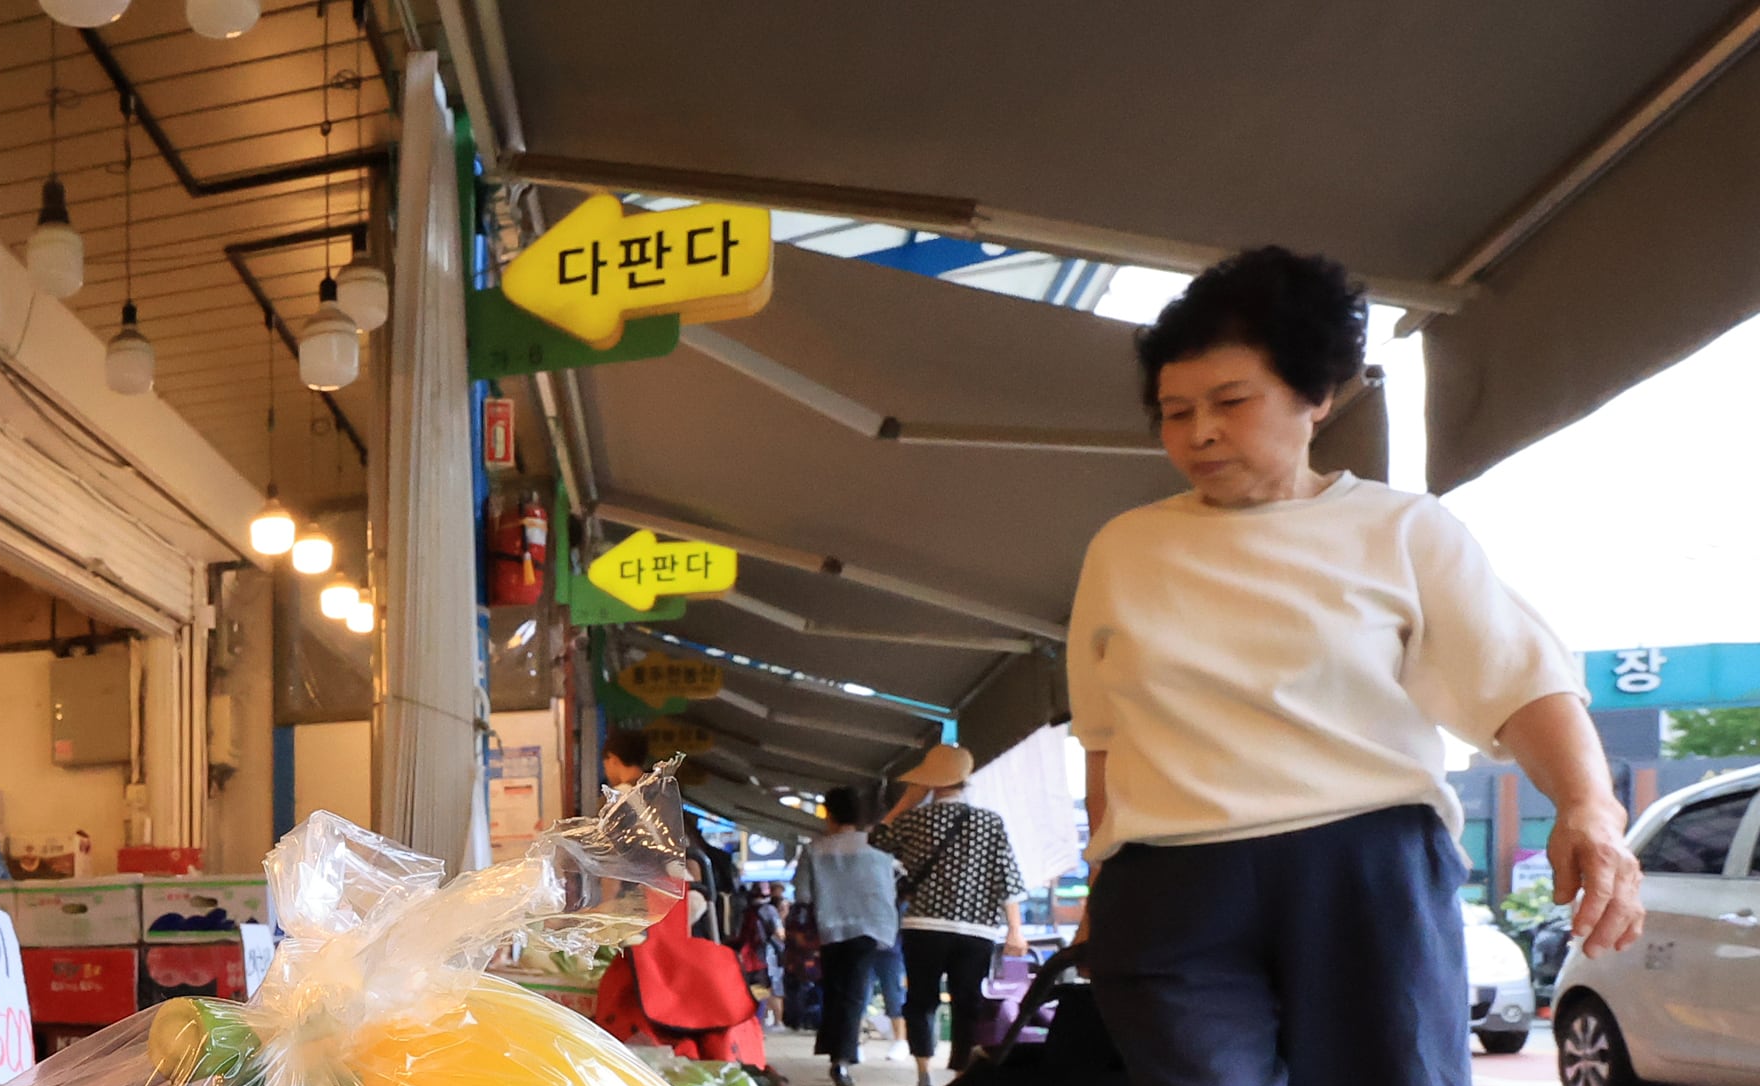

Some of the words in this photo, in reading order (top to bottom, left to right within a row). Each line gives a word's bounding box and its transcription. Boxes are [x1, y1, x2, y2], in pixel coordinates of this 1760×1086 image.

[557, 219, 740, 296] 다판다
[619, 551, 713, 585] 다판다
[1612, 646, 1668, 694] 장
